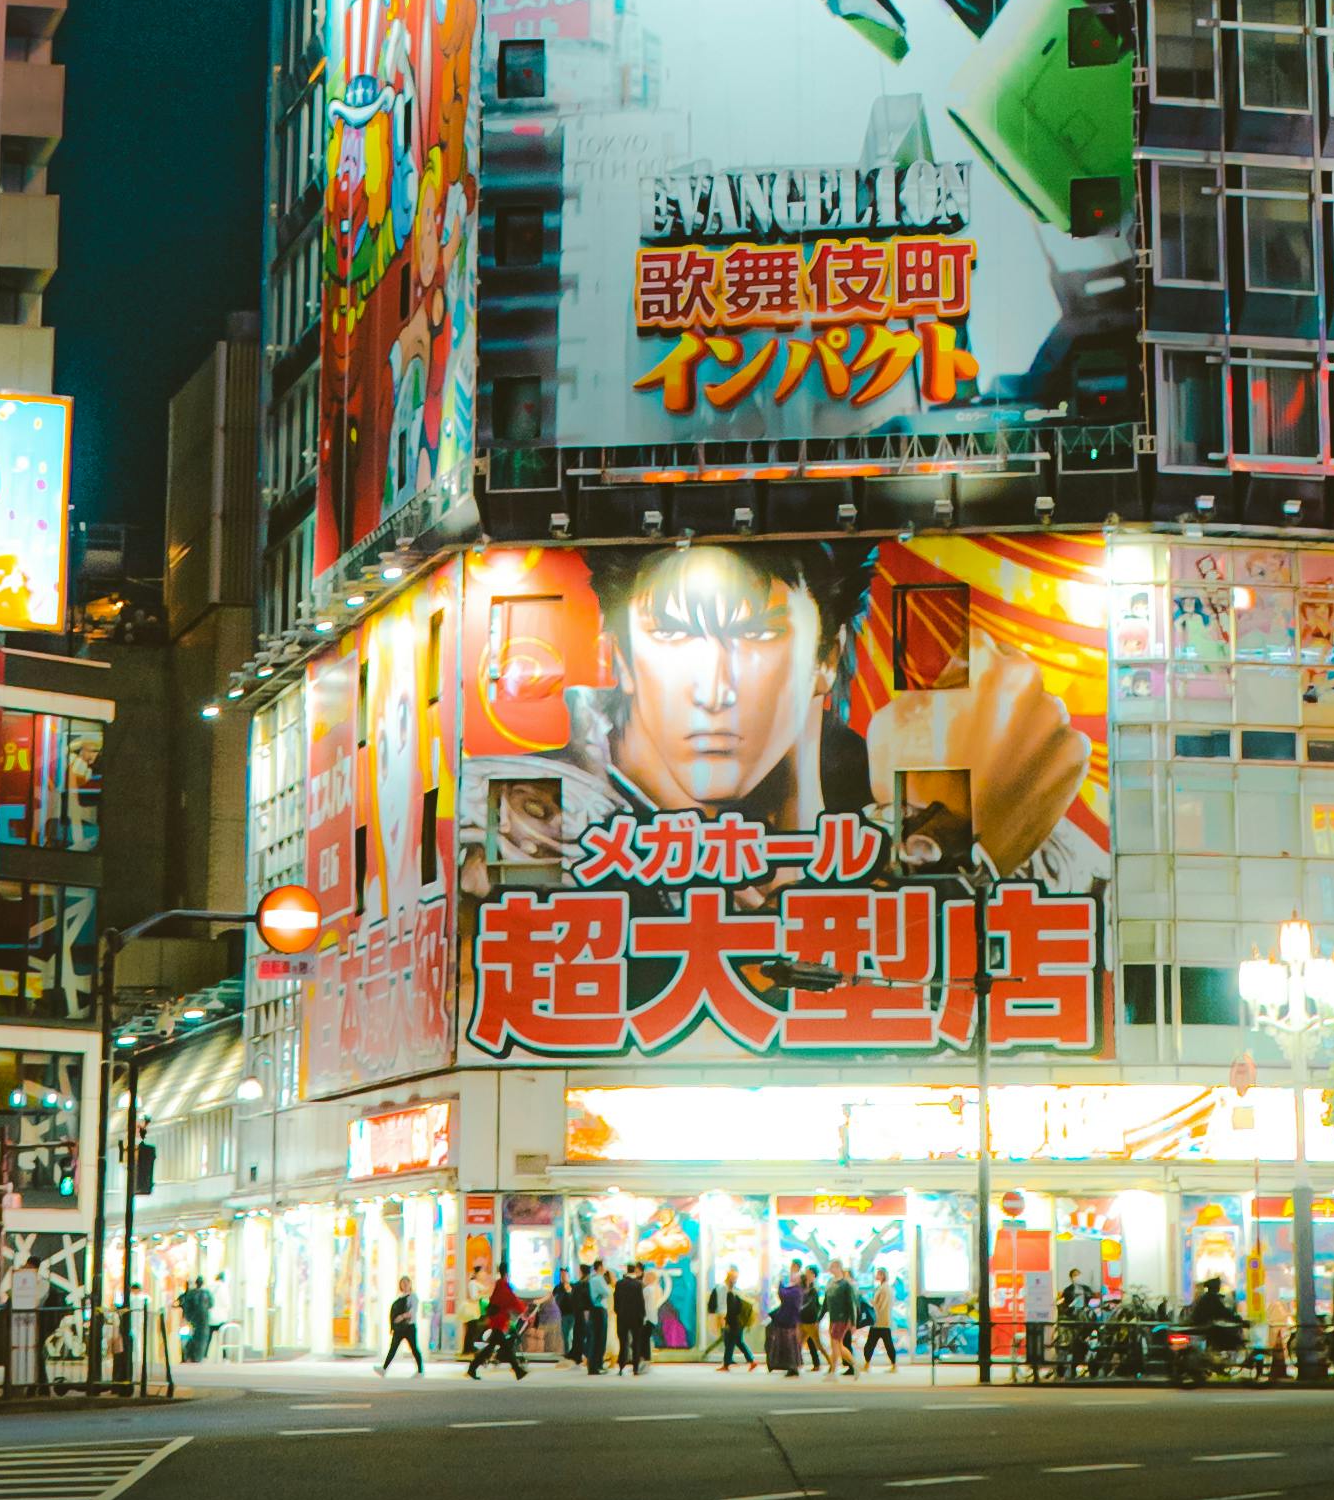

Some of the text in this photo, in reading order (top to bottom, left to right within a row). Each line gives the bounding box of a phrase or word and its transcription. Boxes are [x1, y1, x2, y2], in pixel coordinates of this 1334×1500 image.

[640, 160, 973, 240] EVANGELION
[639, 240, 975, 321] 歌舞伎町
[632, 321, 980, 413] インパクト
[310, 745, 354, 831] エスパス
[578, 815, 882, 884] メガホール
[473, 888, 1093, 1051] 超大型店
